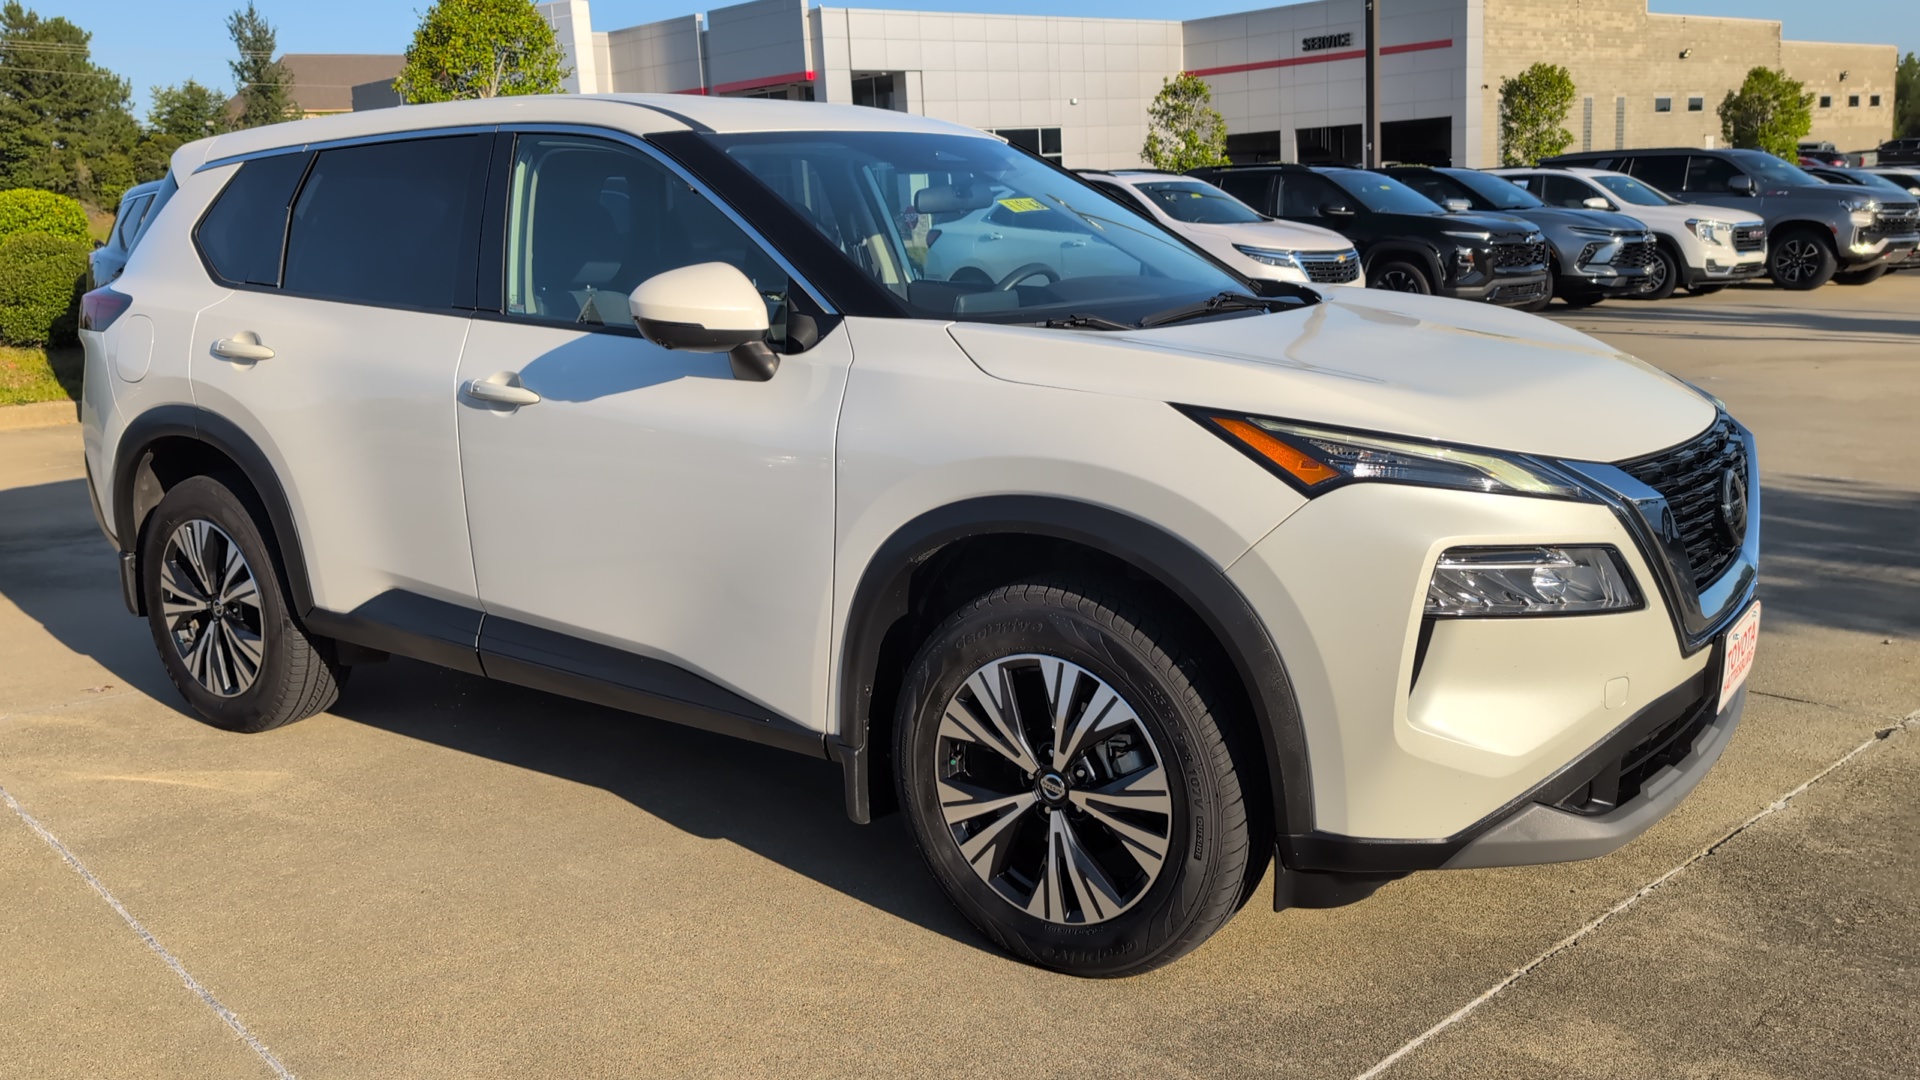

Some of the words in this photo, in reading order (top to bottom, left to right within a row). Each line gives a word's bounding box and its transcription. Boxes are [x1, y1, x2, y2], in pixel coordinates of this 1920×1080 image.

[1301, 32, 1353, 52] SERVICE
[1726, 621, 1756, 676] TOYOTA
[1194, 816, 1204, 861] OUTSIDE
